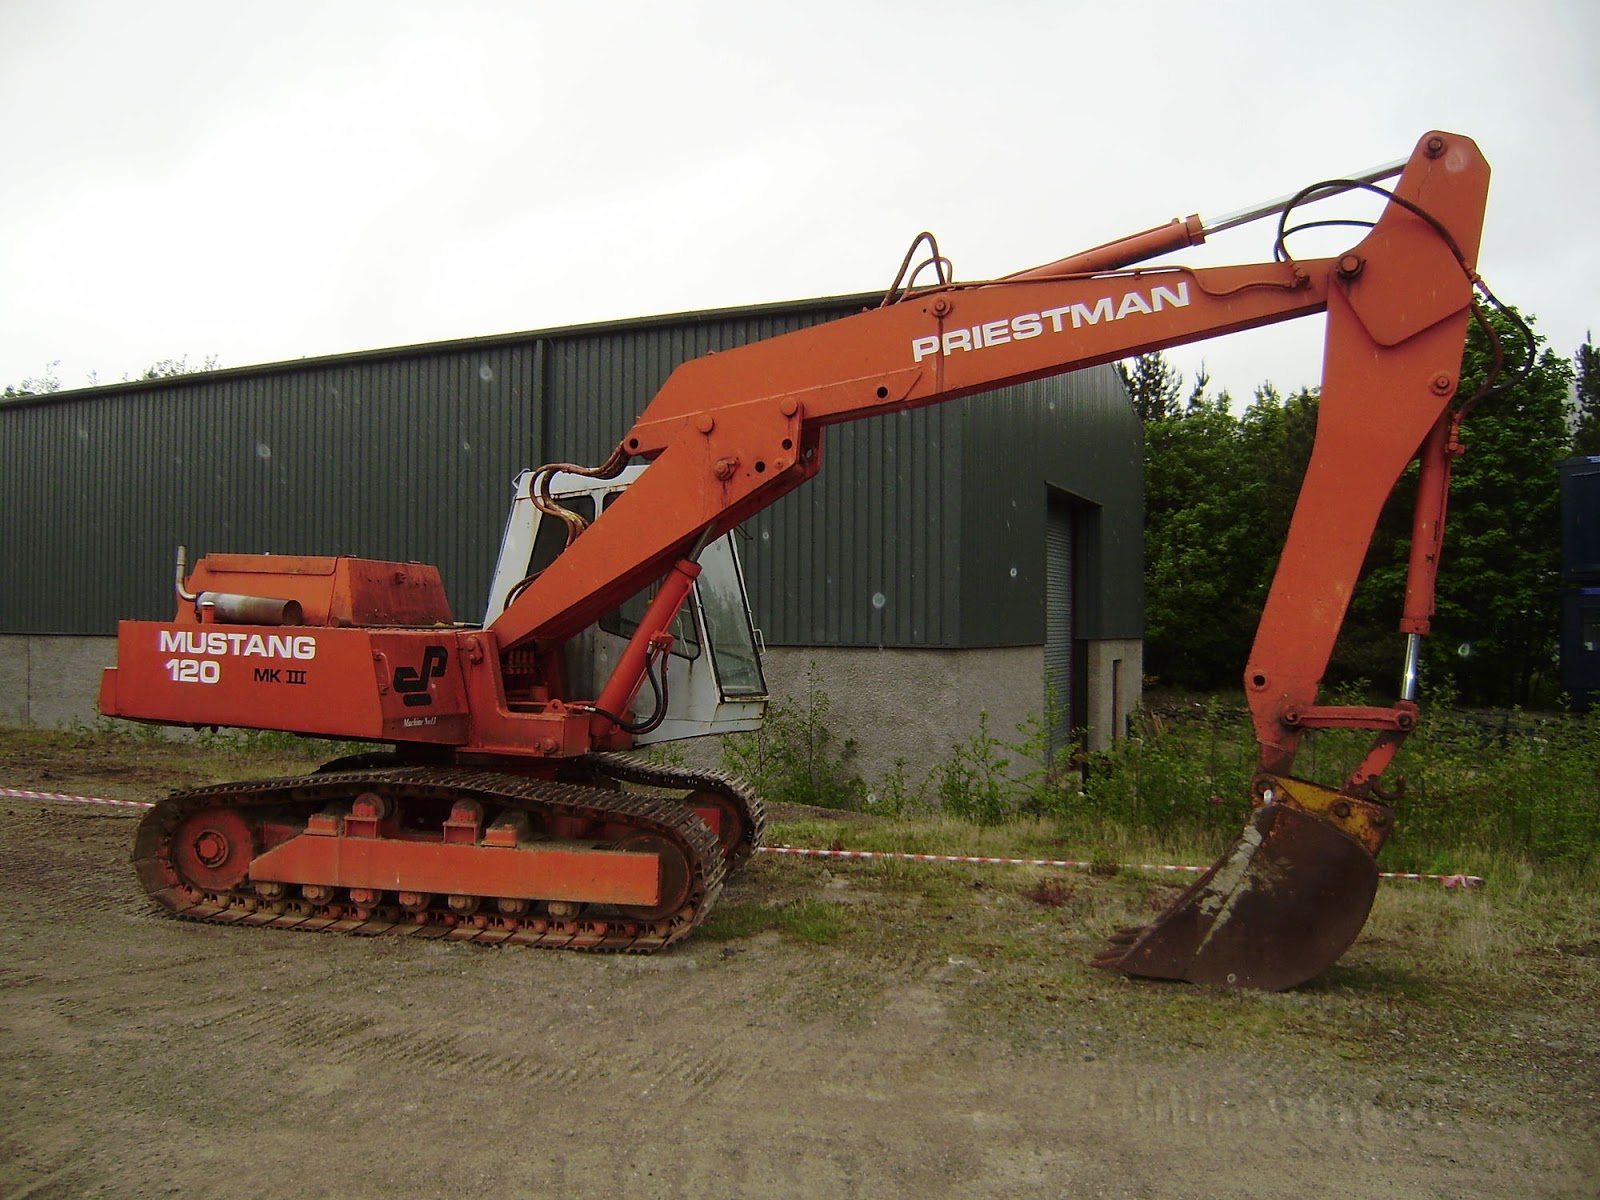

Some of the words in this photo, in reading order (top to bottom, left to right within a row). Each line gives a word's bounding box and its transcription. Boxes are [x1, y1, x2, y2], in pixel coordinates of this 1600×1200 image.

[912, 281, 1190, 363] PRIESTMAN
[159, 630, 316, 660] MUSTANG
[165, 659, 221, 684] 120
[253, 668, 281, 683] MK
[286, 669, 307, 685] III
